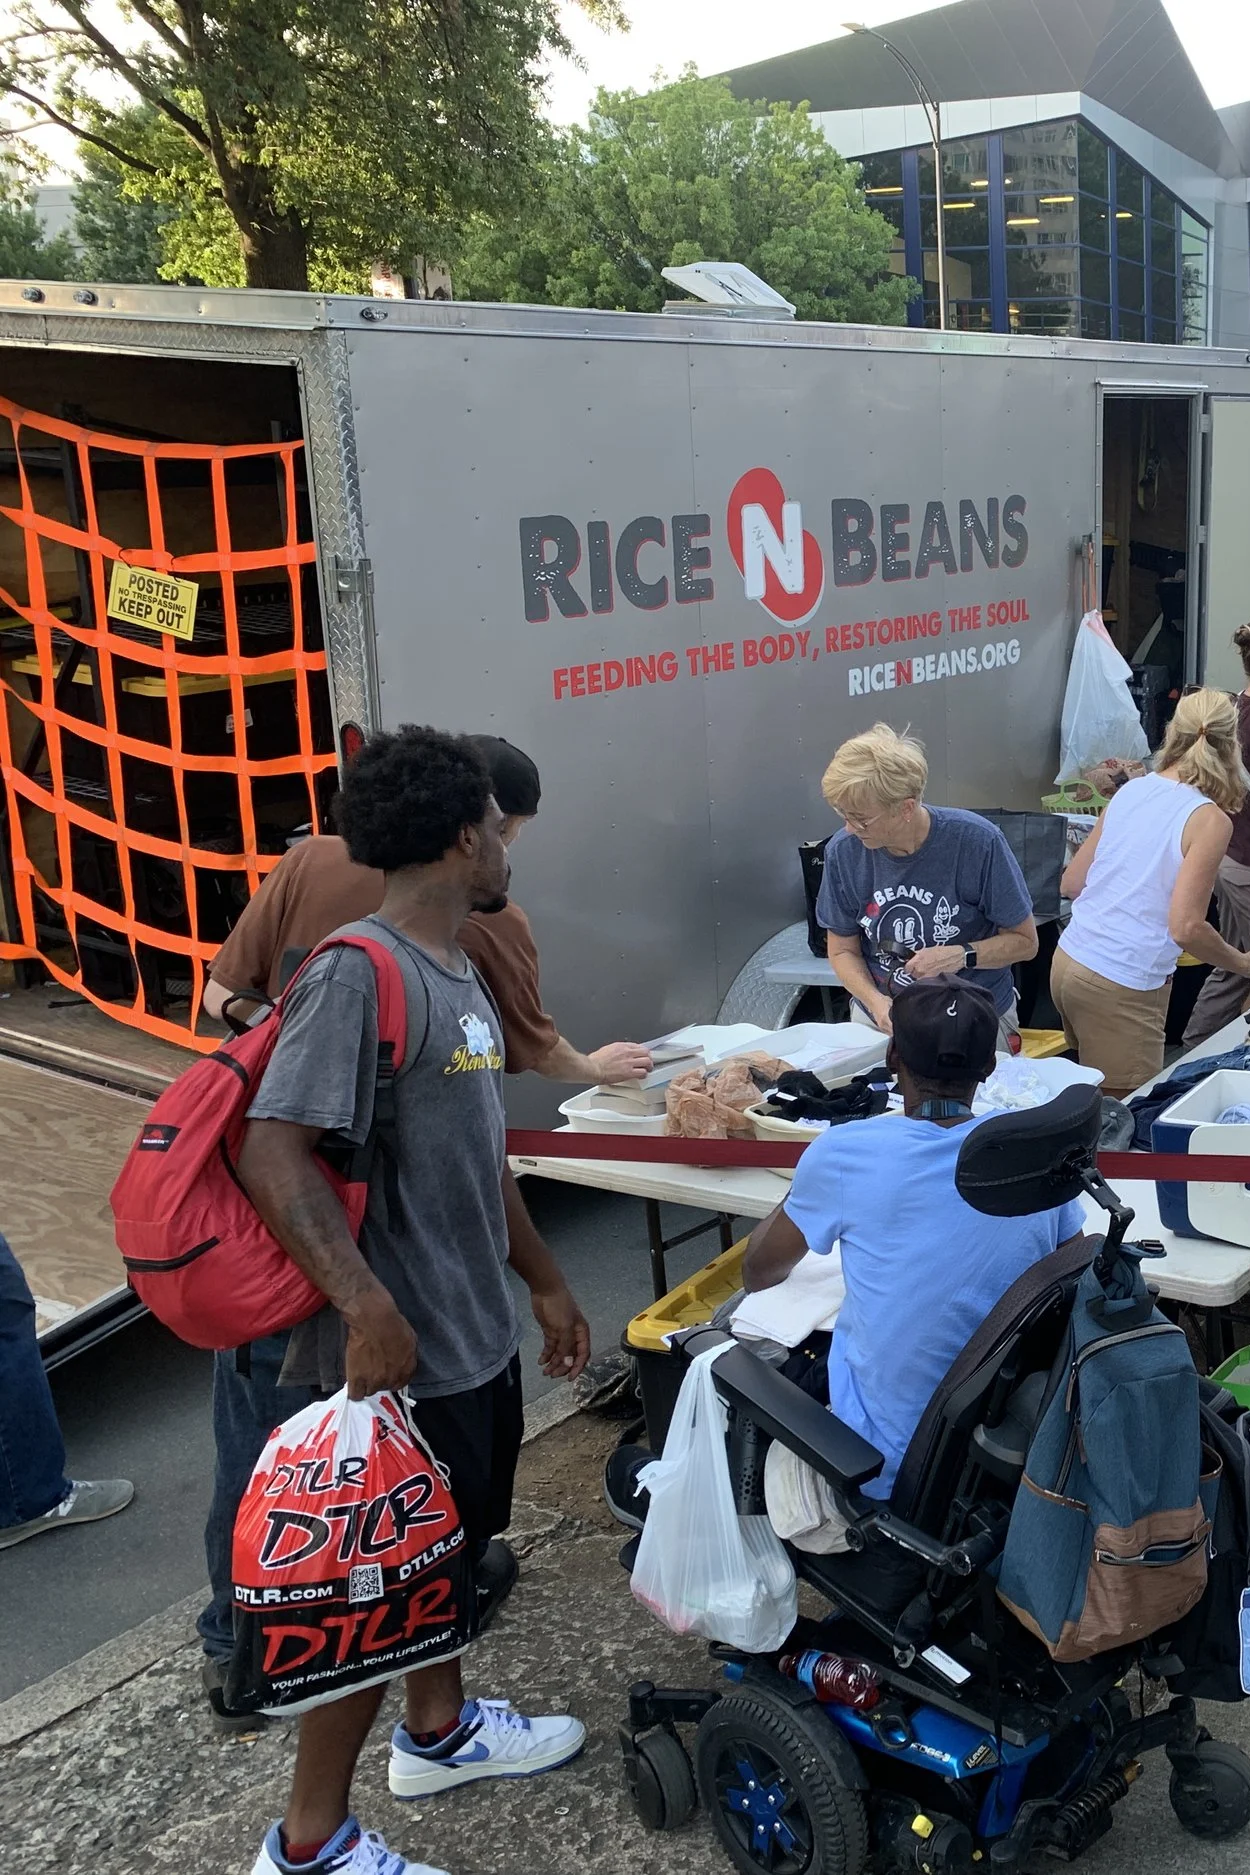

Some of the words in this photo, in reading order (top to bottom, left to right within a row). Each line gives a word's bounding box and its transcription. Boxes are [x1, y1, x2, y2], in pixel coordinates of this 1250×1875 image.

[519, 513, 714, 623] RICE
[740, 501, 804, 601] N
[831, 494, 1029, 588] BEANS
[118, 587, 130, 597] NO
[132, 591, 187, 614] TRESPASSING
[128, 574, 179, 602] POSTED
[118, 597, 153, 619] KEEP
[156, 608, 184, 629] OUT
[553, 651, 679, 700] FEEDING
[686, 642, 735, 678] THE
[742, 631, 820, 669] BODY,
[825, 611, 943, 654] RESTORING
[948, 603, 983, 634] THE
[987, 598, 1030, 626] SOUL
[847, 638, 1022, 697] RICENBEANS.ORG
[873, 885, 934, 907] BEANS
[266, 1455, 368, 1496] DTLR
[258, 1472, 447, 1570] DTLR
[399, 1526, 465, 1581] DTLR.CO
[235, 1585, 333, 1604] DTLR.COM
[261, 1579, 456, 1676] DTLR
[271, 1675, 305, 1691] YOUR
[362, 1653, 394, 1668] YOUR
